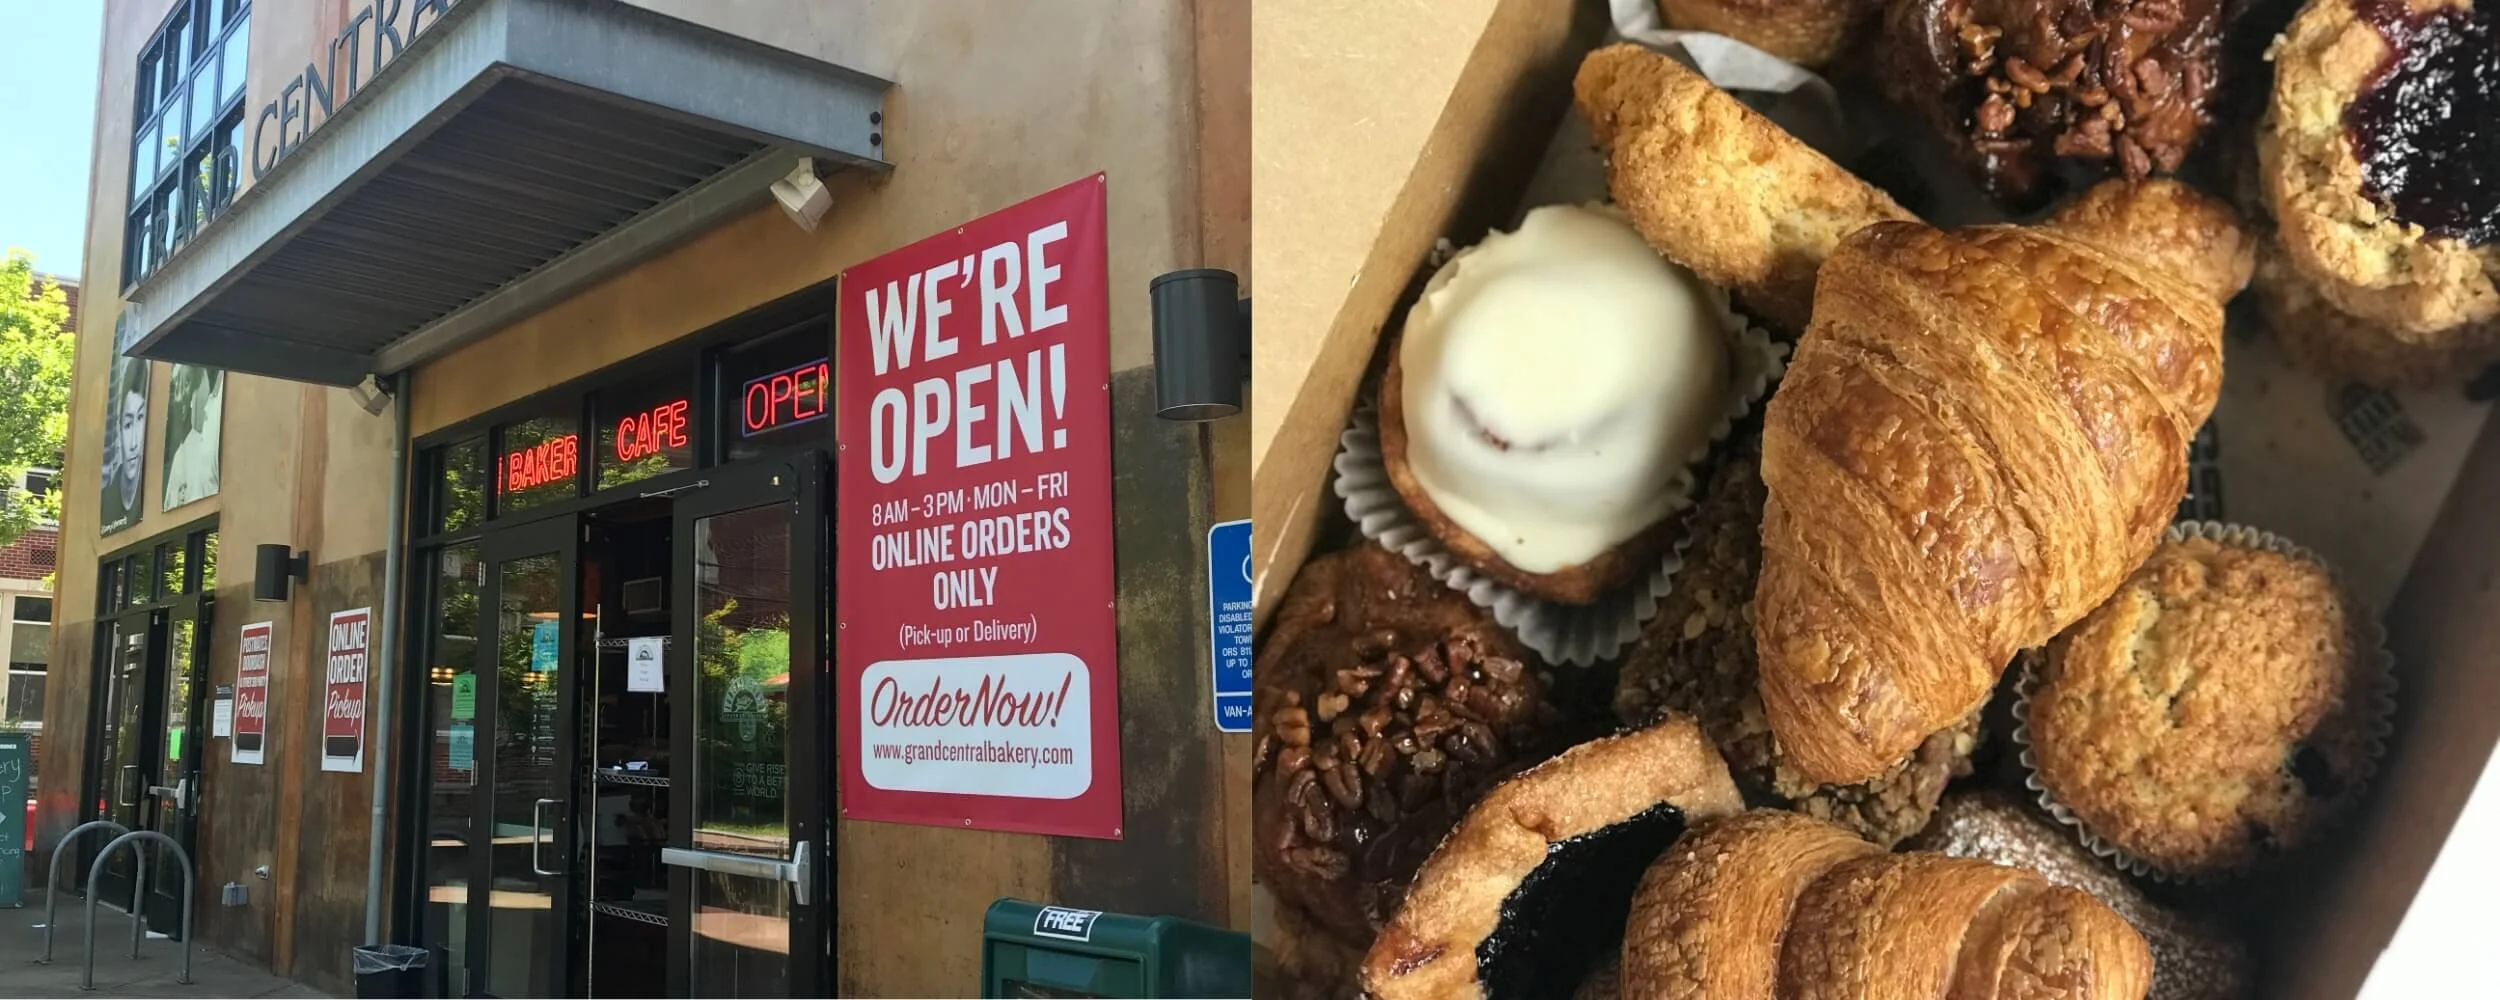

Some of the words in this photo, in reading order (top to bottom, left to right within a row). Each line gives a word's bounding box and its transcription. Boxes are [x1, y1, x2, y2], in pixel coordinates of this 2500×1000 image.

[134, 144, 239, 283] GRAND
[865, 220, 1069, 376] WE'RE
[617, 399, 688, 462] CAFE
[870, 343, 1067, 484] OPEN!
[508, 435, 577, 491] BAKER
[872, 524, 955, 570] ONLINE
[961, 507, 1071, 560] ORDERS
[933, 566, 998, 610] ONLY
[332, 620, 367, 651] ONLINE
[900, 623, 952, 650] (Pick-up
[955, 626, 970, 643] or
[973, 613, 1038, 643] Delivery)
[329, 653, 363, 684] ORDER
[1226, 659, 1236, 668] UP
[1238, 657, 1249, 668] TO
[239, 690, 263, 726] Pickup
[328, 688, 362, 727] Pickup
[873, 740, 1073, 768] www.grandcentralbakery.com
[1043, 909, 1089, 932] FREE
